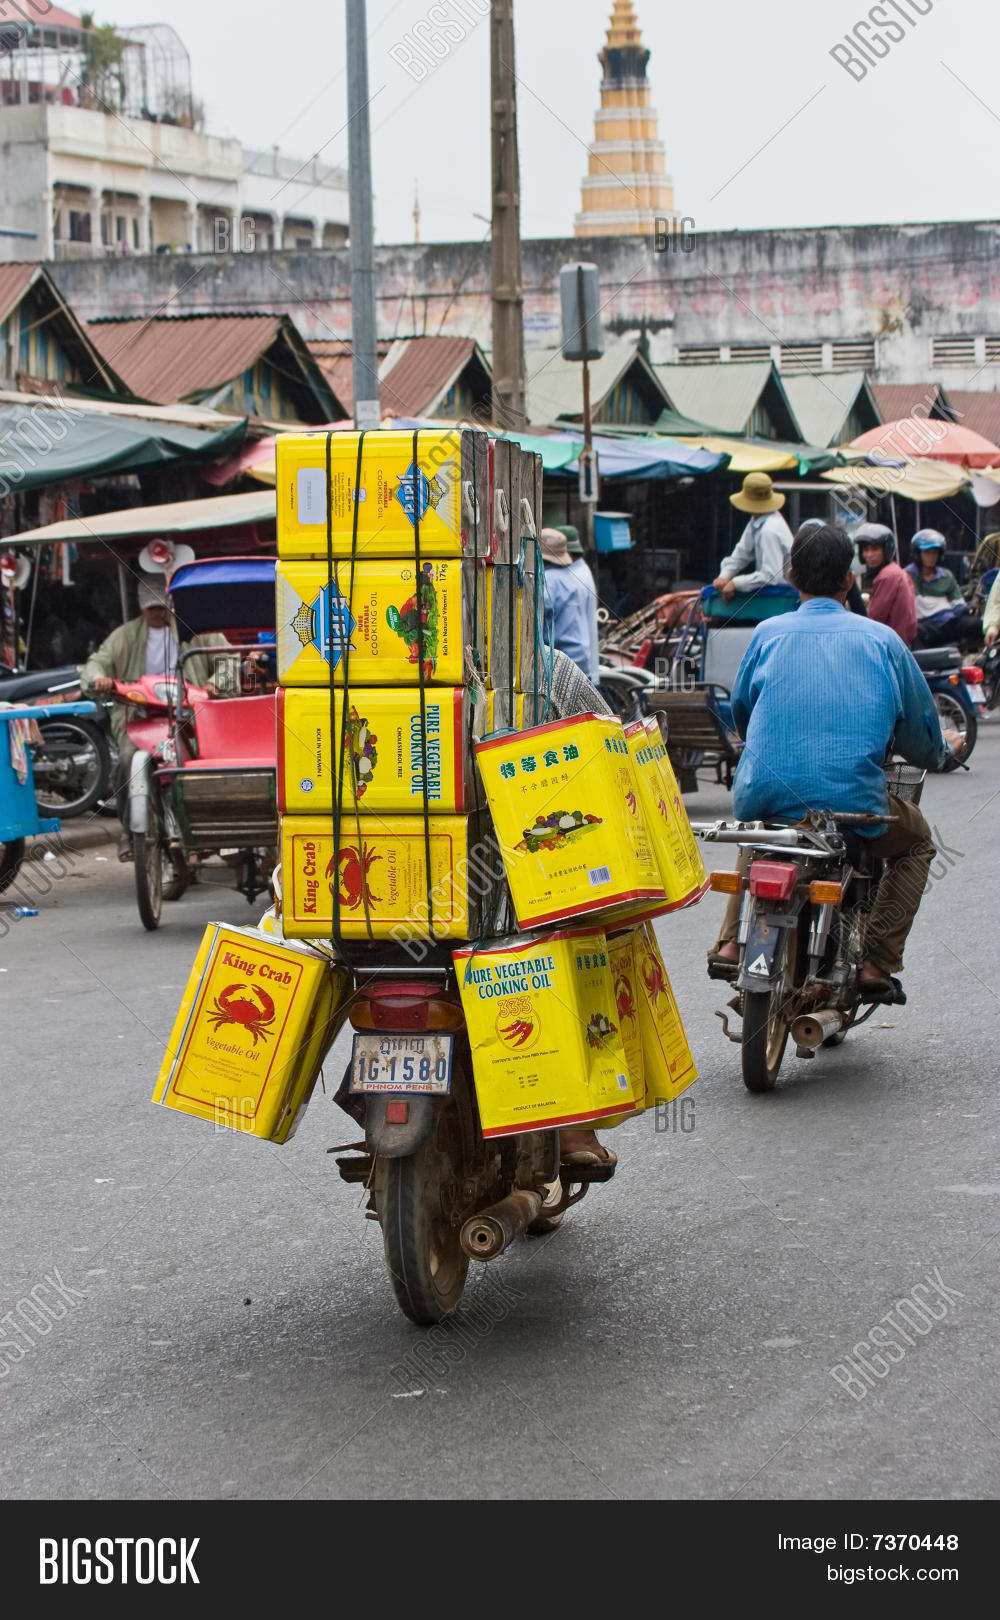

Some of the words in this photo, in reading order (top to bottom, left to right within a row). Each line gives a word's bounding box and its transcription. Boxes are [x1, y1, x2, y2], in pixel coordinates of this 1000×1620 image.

[370, 610, 378, 656] COOKING
[425, 704, 440, 734] PURE
[410, 714, 424, 772] COOKING
[426, 736, 441, 800] VEGETABLE
[500, 744, 579, 779] 特等食油
[411, 774, 424, 795] OIL
[303, 841, 316, 877] Crab
[387, 849, 397, 864] Oil
[303, 880, 320, 914] King
[388, 866, 399, 906] Vegetable
[222, 951, 257, 976] King
[258, 963, 292, 985] Crab
[494, 955, 555, 981] VEGETABLE
[478, 977, 529, 1000] COOKING
[532, 973, 552, 990] OIL
[497, 995, 533, 1018] 333
[206, 1036, 244, 1057] Vegetable
[244, 1049, 260, 1062] Oil
[405, 1083, 433, 1091] PENH
